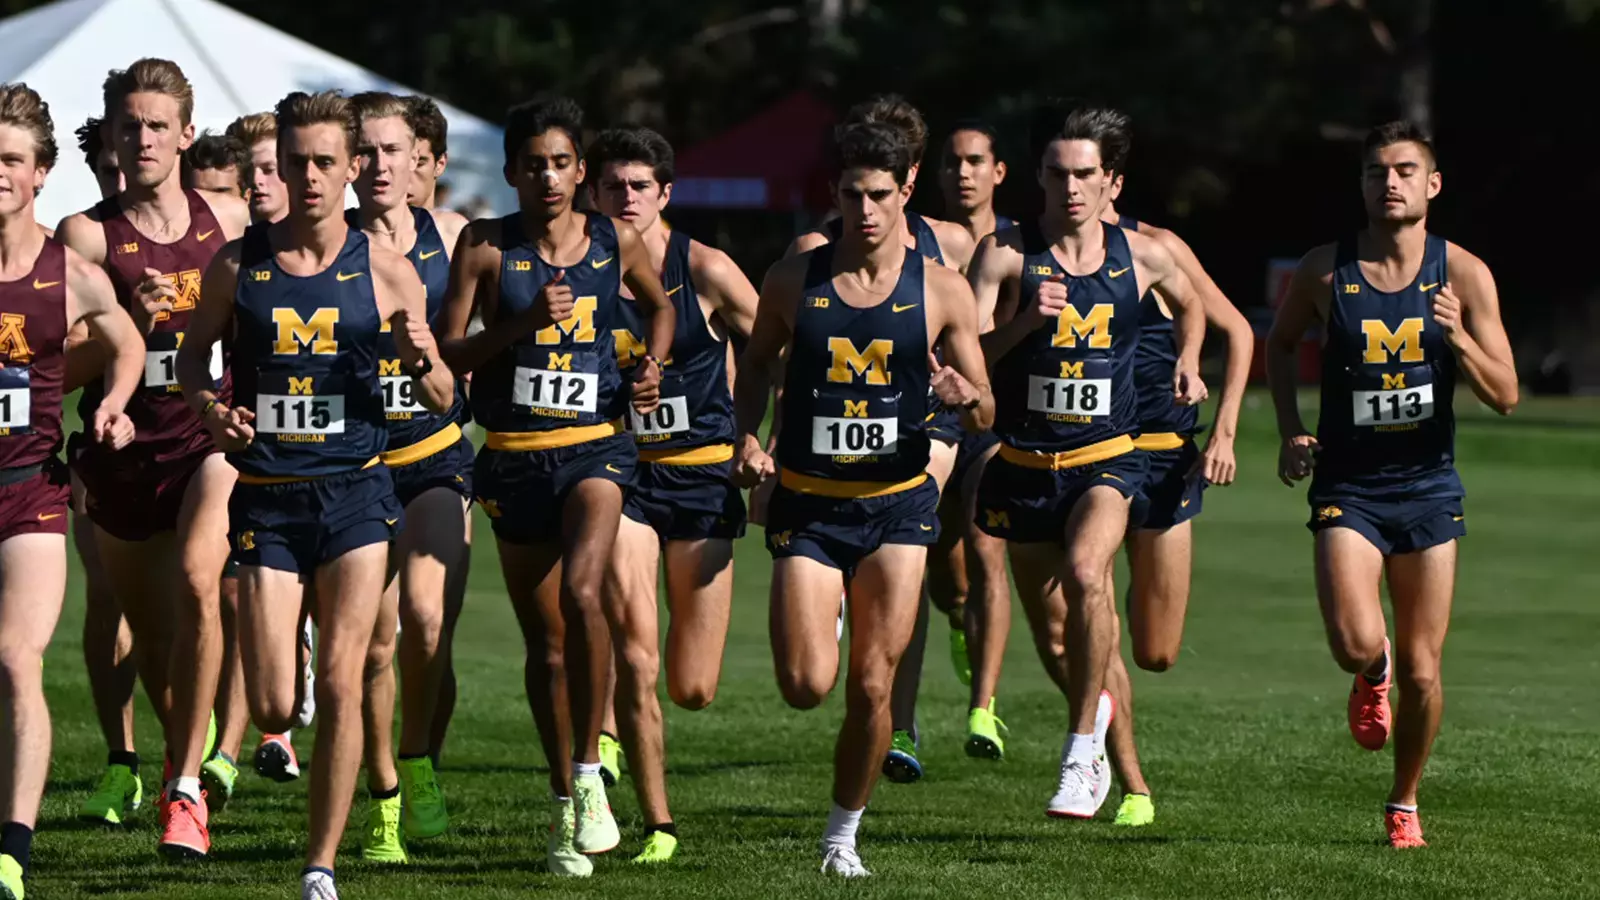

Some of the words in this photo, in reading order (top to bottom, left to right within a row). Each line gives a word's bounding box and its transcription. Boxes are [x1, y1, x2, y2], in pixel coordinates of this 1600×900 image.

[272, 307, 340, 355] M
[535, 295, 599, 345] M
[1051, 303, 1115, 349] M
[1361, 317, 1425, 364] M
[378, 358, 401, 376] M
[547, 351, 573, 371] M
[826, 336, 894, 386] M
[1060, 361, 1085, 379] M
[288, 376, 314, 395] M
[381, 380, 417, 408] 19
[528, 373, 587, 407] 112
[1381, 372, 1406, 390] M
[843, 399, 868, 418] M
[1042, 382, 1099, 412] 118
[1366, 391, 1422, 421] 113
[271, 400, 331, 429] 115
[530, 406, 578, 420] MICHIGAN
[1046, 413, 1092, 424] MICHIGAN
[277, 433, 326, 443] MICHIGAN
[826, 422, 885, 451] 108
[831, 454, 879, 464] MICHIGAN
